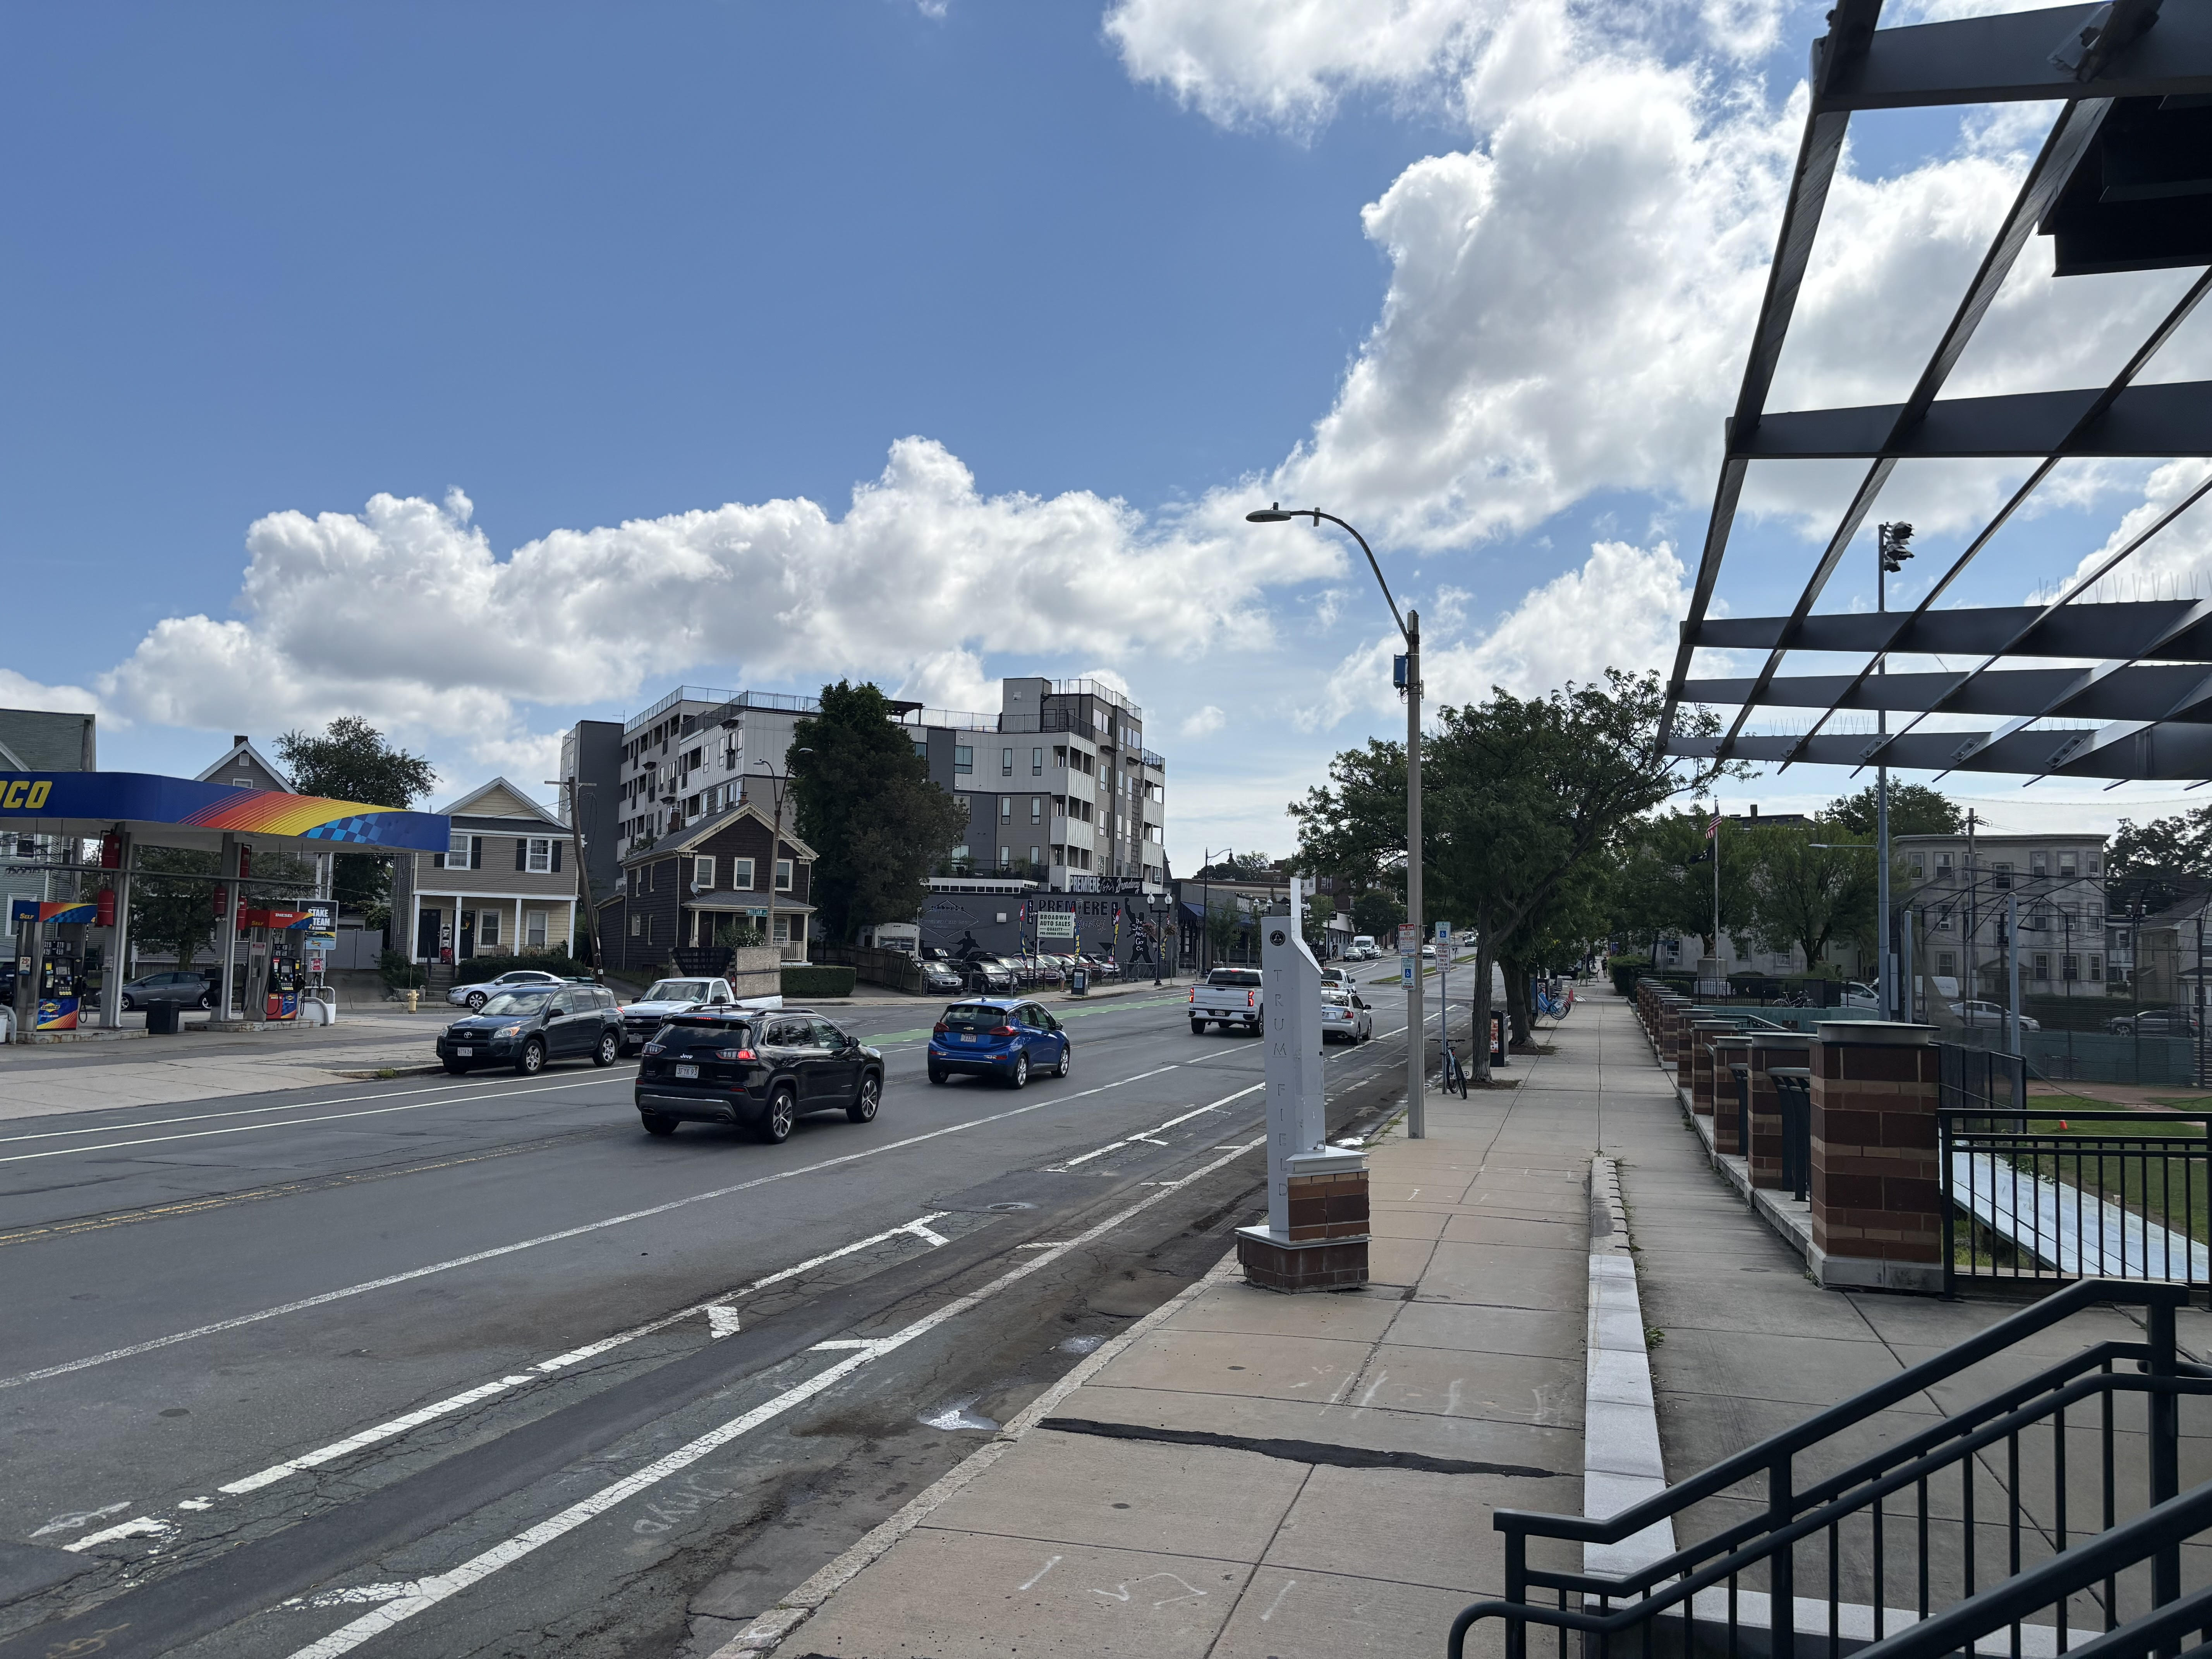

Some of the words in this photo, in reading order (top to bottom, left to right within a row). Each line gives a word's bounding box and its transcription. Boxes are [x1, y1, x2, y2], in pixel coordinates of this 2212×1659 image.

[0, 781, 53, 808] CO
[1070, 876, 1101, 893] PREMIERE
[1115, 877, 1140, 894] Broadway
[313, 918, 330, 926] TEAM
